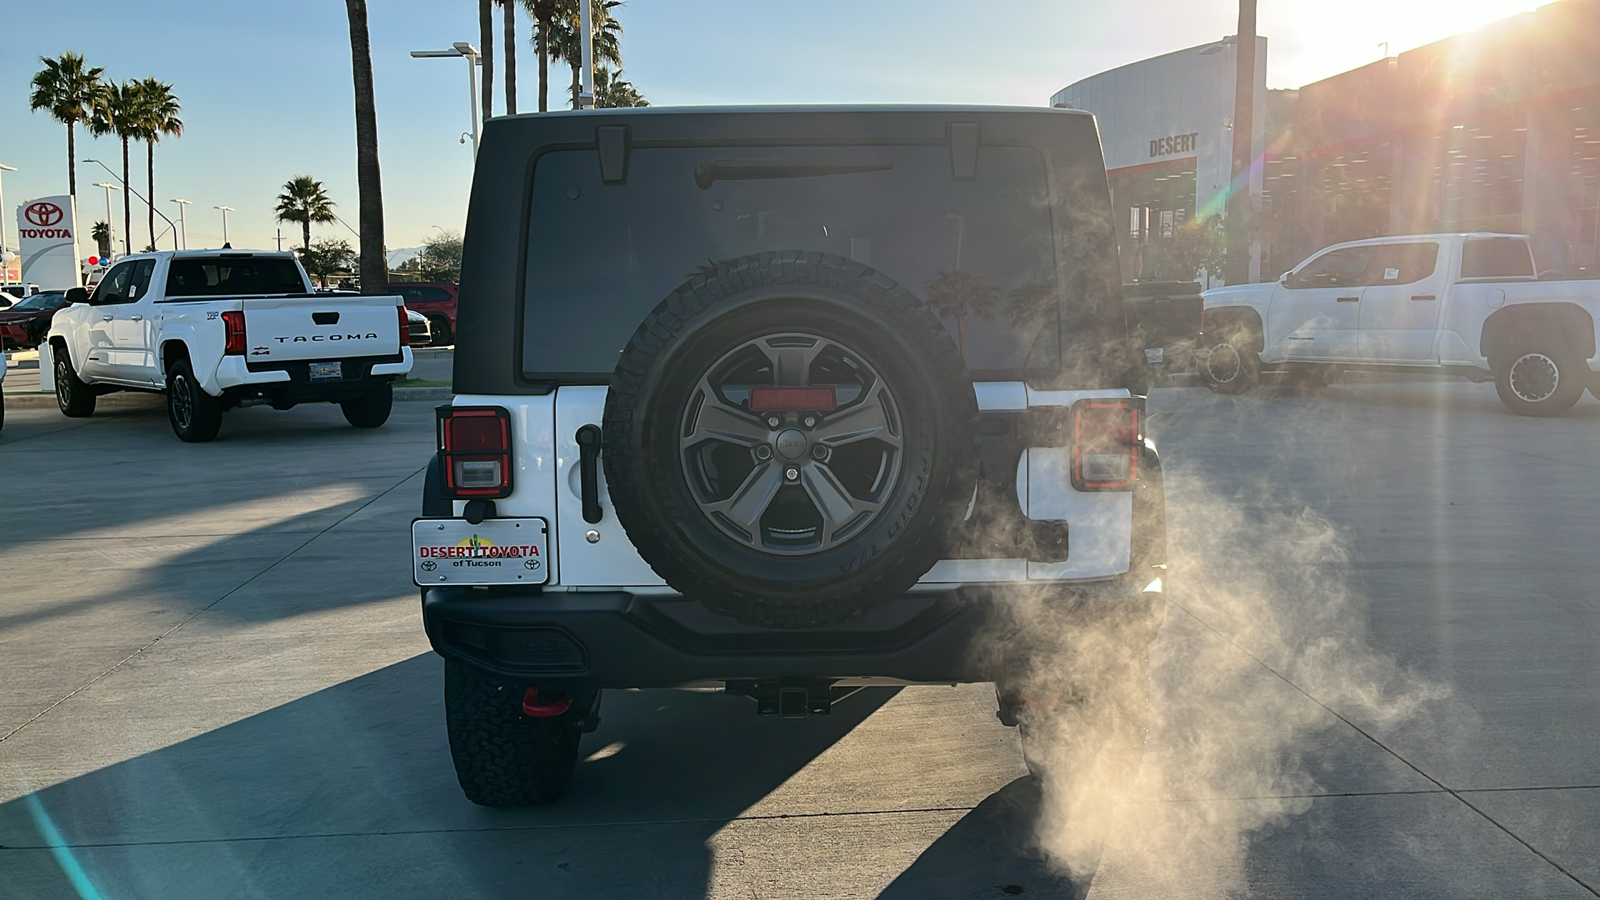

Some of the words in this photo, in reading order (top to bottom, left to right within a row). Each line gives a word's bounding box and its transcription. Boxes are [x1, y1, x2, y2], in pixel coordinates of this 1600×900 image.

[1149, 132, 1198, 158] DESERT
[19, 228, 72, 239] TOYOTA
[274, 333, 378, 343] TACOMA
[420, 546, 475, 558] DESERT
[479, 545, 540, 557] TOYOTA
